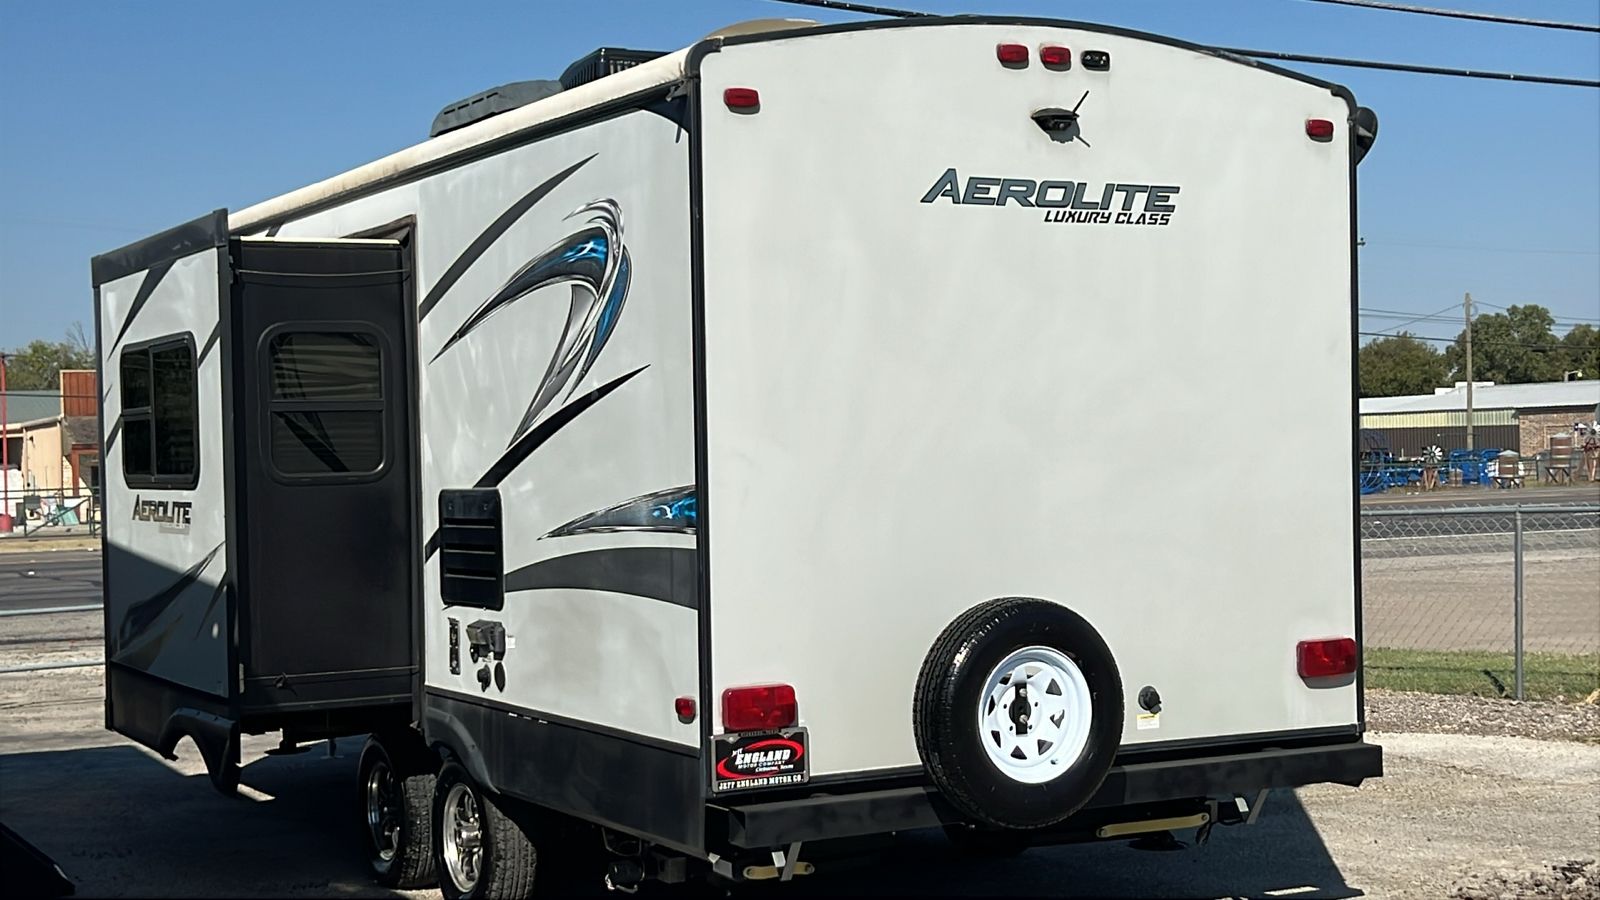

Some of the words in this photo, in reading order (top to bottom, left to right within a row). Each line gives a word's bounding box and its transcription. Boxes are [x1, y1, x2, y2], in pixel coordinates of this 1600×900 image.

[919, 167, 1181, 213] AEROLITE
[1044, 210, 1112, 224] LUXURY
[1114, 212, 1171, 226] CLASS
[132, 494, 192, 525] AEROLITE
[735, 749, 791, 765] ENGLAND
[719, 781, 735, 790] JEFF
[736, 777, 768, 788] ENGLAND
[769, 775, 792, 785] MOTOR
